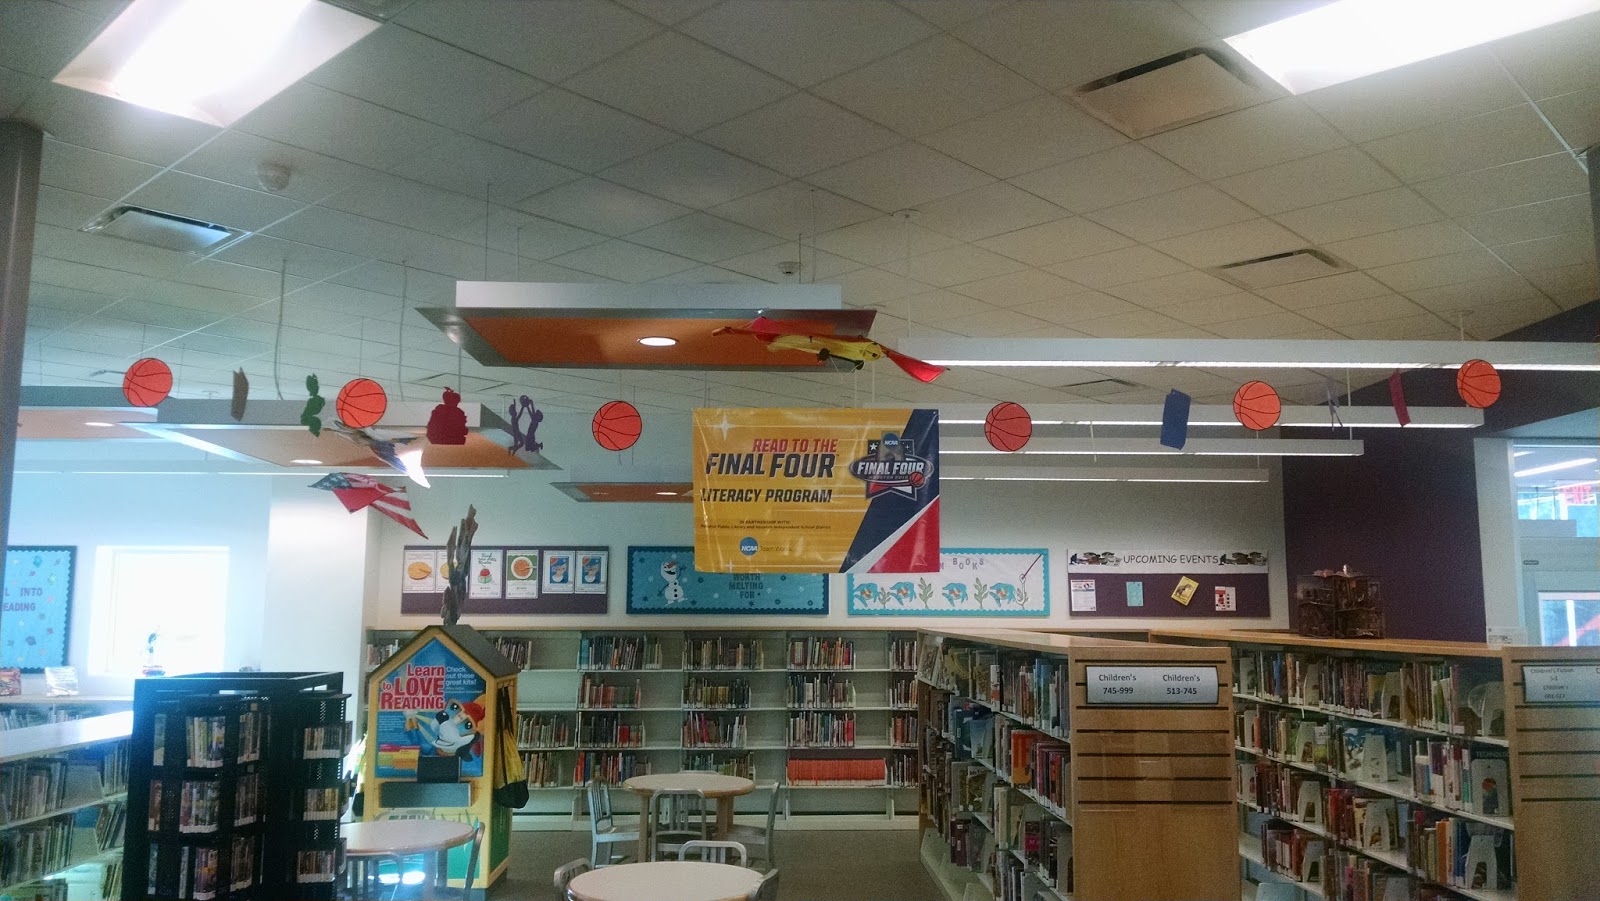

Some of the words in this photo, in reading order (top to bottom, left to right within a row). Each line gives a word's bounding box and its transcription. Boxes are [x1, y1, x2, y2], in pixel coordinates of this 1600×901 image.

[752, 438, 789, 453] READ
[792, 438, 809, 453] TO
[813, 438, 839, 453] THE
[705, 453, 766, 475] FINAL
[769, 453, 836, 478] FOUR
[857, 462, 891, 475] FINAL
[892, 462, 925, 475] FOUR
[700, 488, 762, 503] LITERACY
[765, 489, 833, 503] PROGRAM
[952, 557, 985, 570] BOOKS
[1123, 555, 1177, 564] UPCOMING
[1180, 555, 1219, 564] EVENTS
[733, 573, 761, 581] WORTH
[729, 581, 764, 590] MELTING
[20, 587, 43, 597] INTO
[740, 591, 755, 599] FOR
[3, 602, 36, 612] EADING
[407, 663, 446, 677] Learn
[1098, 674, 1137, 682] Children's
[1162, 674, 1201, 682] Children's
[382, 681, 392, 691] to
[394, 677, 445, 696] LOVE
[1103, 687, 1134, 695] 745-999
[1166, 687, 1197, 695] 513-745
[380, 691, 445, 710] READING
